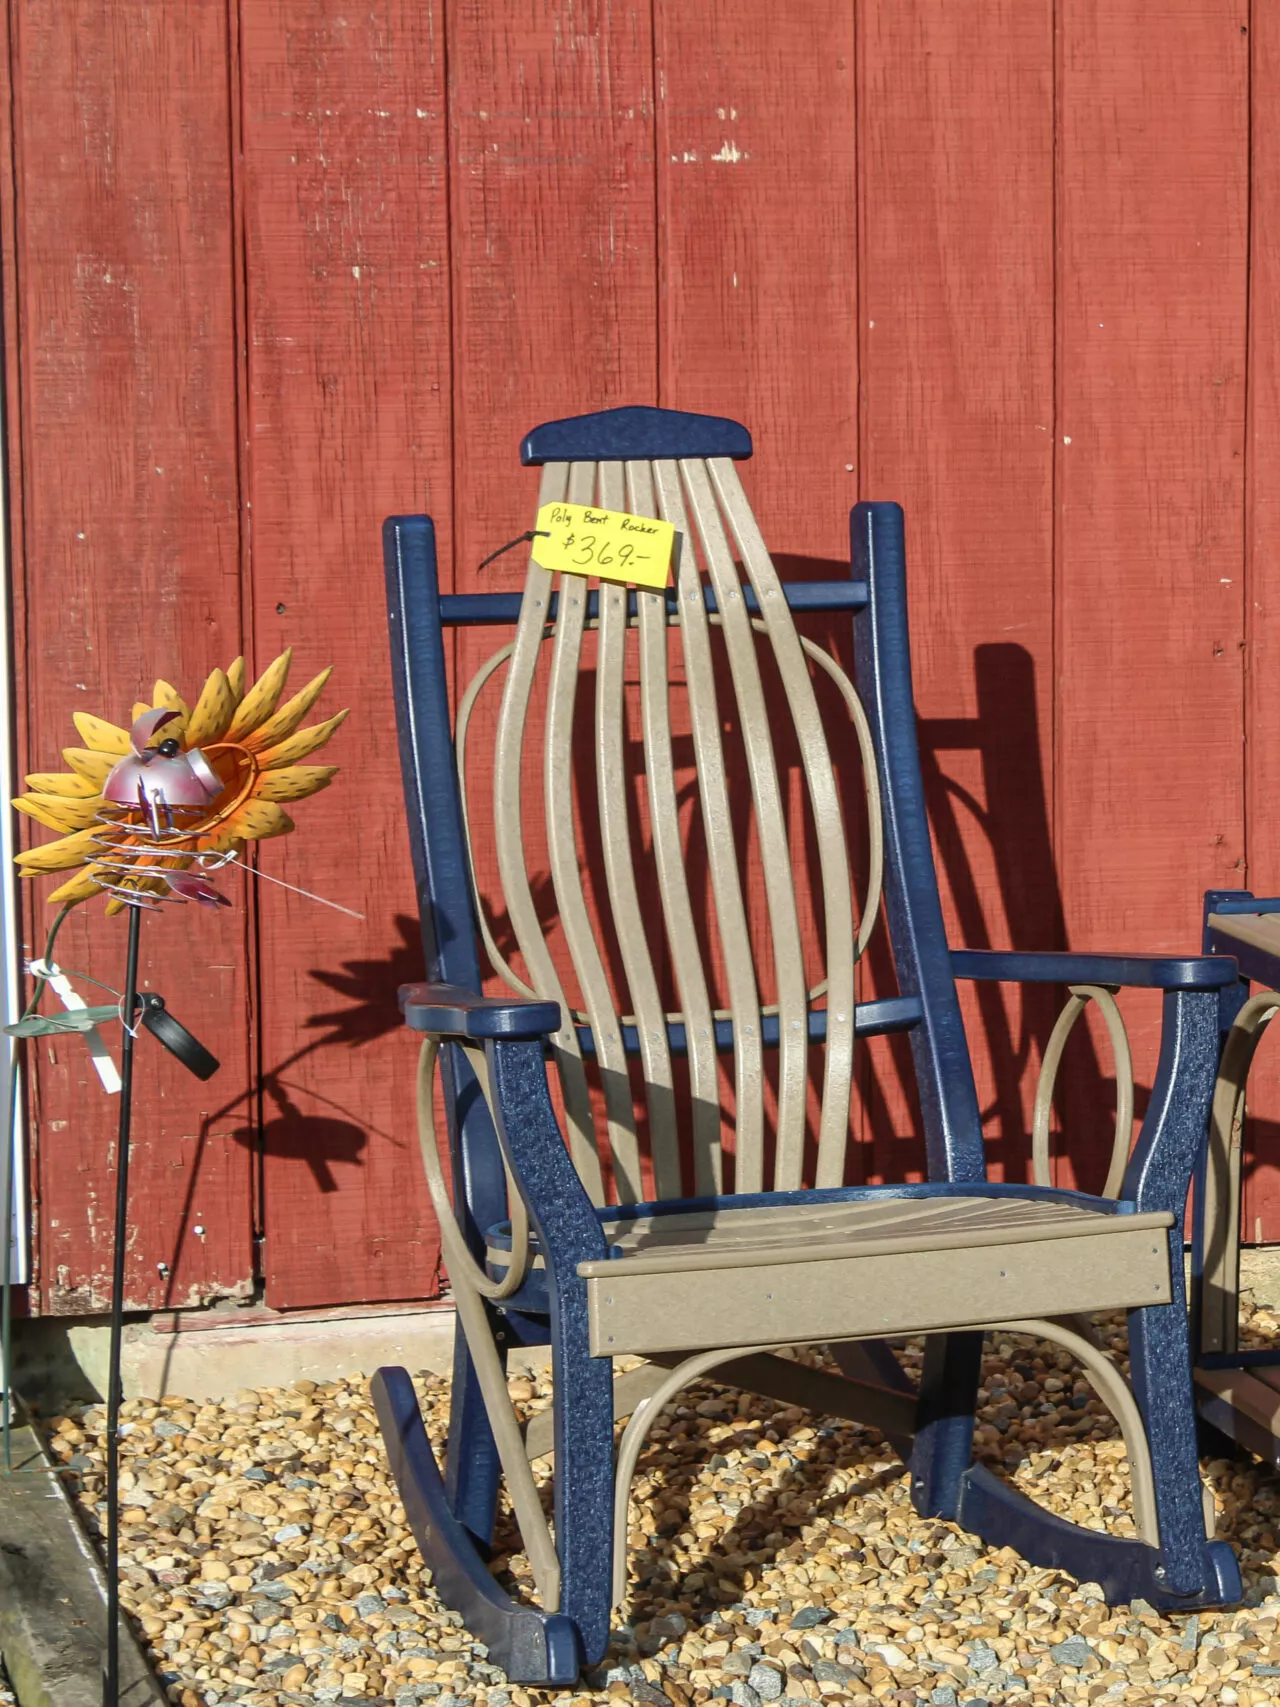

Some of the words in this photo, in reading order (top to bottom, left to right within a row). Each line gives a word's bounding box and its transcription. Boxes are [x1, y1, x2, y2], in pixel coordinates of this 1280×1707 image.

[550, 508, 571, 527] Poly
[583, 511, 608, 524] Bent
[620, 519, 660, 534] Rocker
